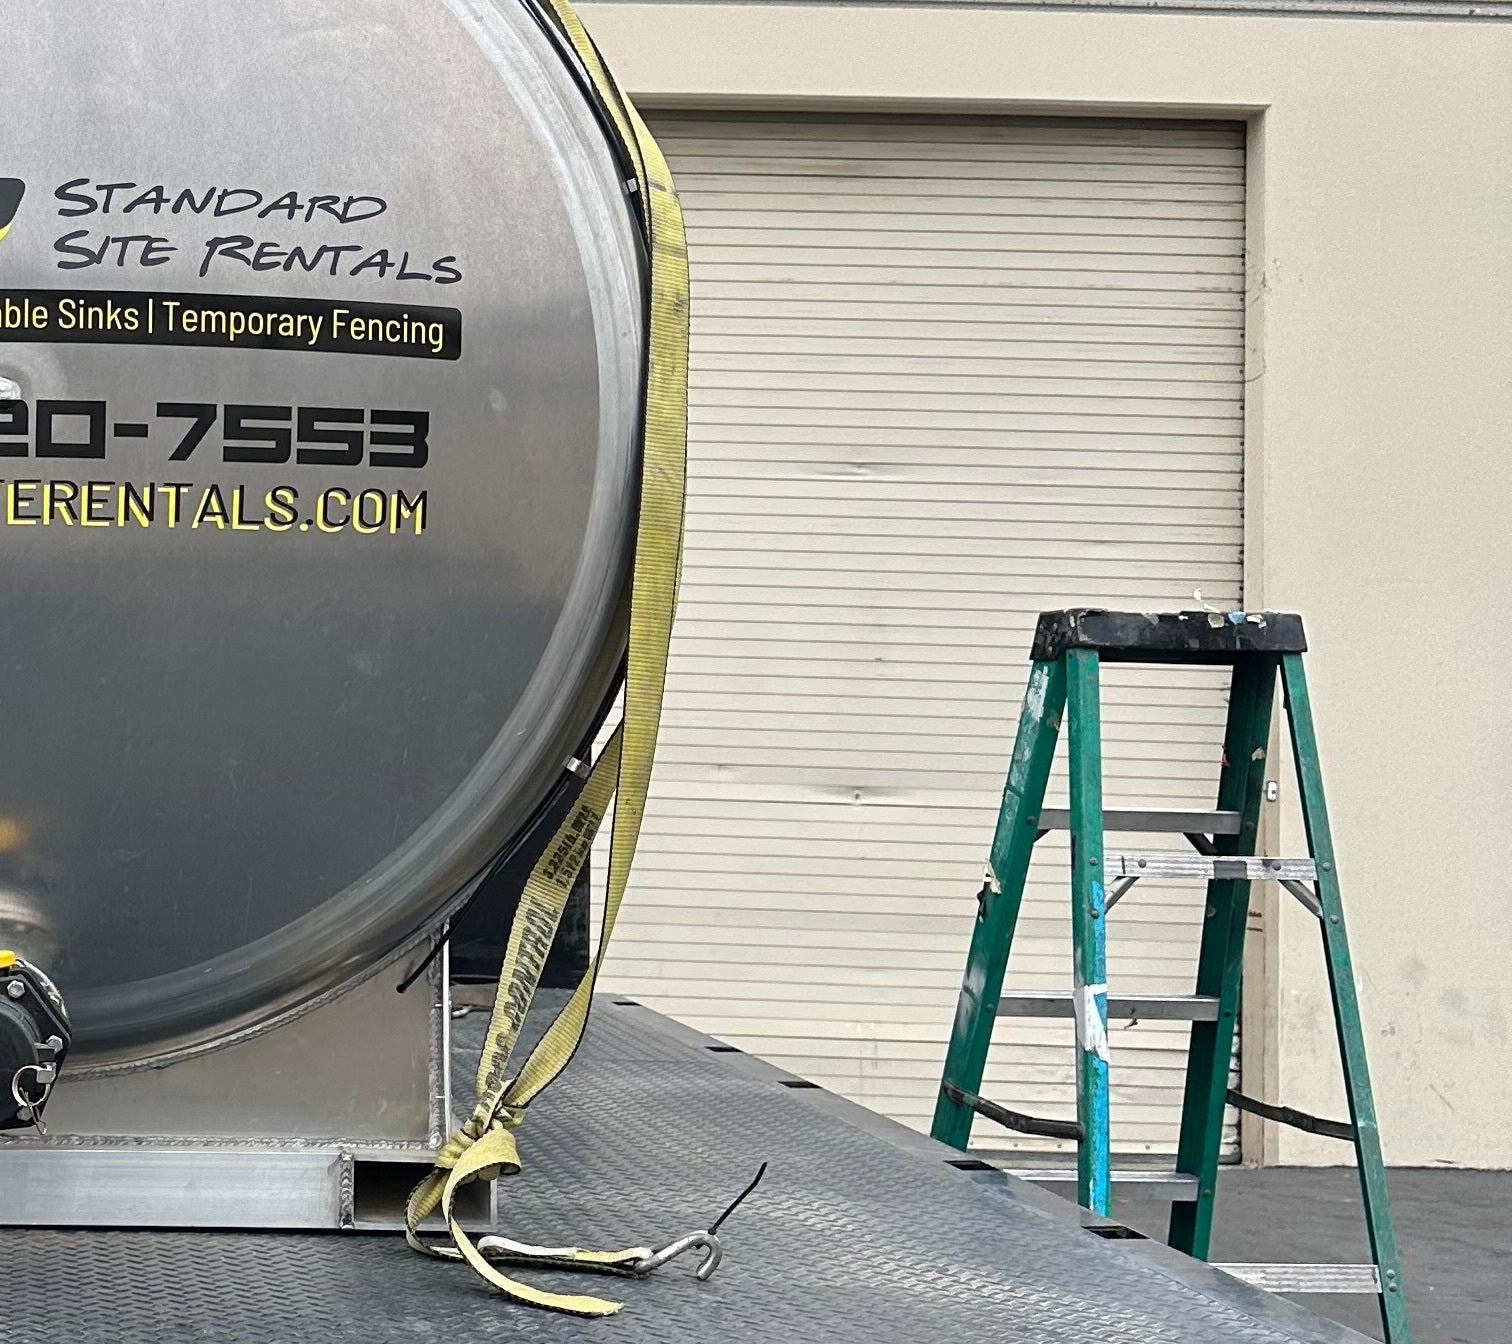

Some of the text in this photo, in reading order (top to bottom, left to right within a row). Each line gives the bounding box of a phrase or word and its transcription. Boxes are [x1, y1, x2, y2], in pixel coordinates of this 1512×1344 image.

[54, 178, 388, 224] STANDARD
[53, 230, 463, 284] SITE RENTALS
[58, 298, 139, 331] Sinks
[162, 301, 324, 346] Temporary
[332, 309, 444, 351] Fencing
